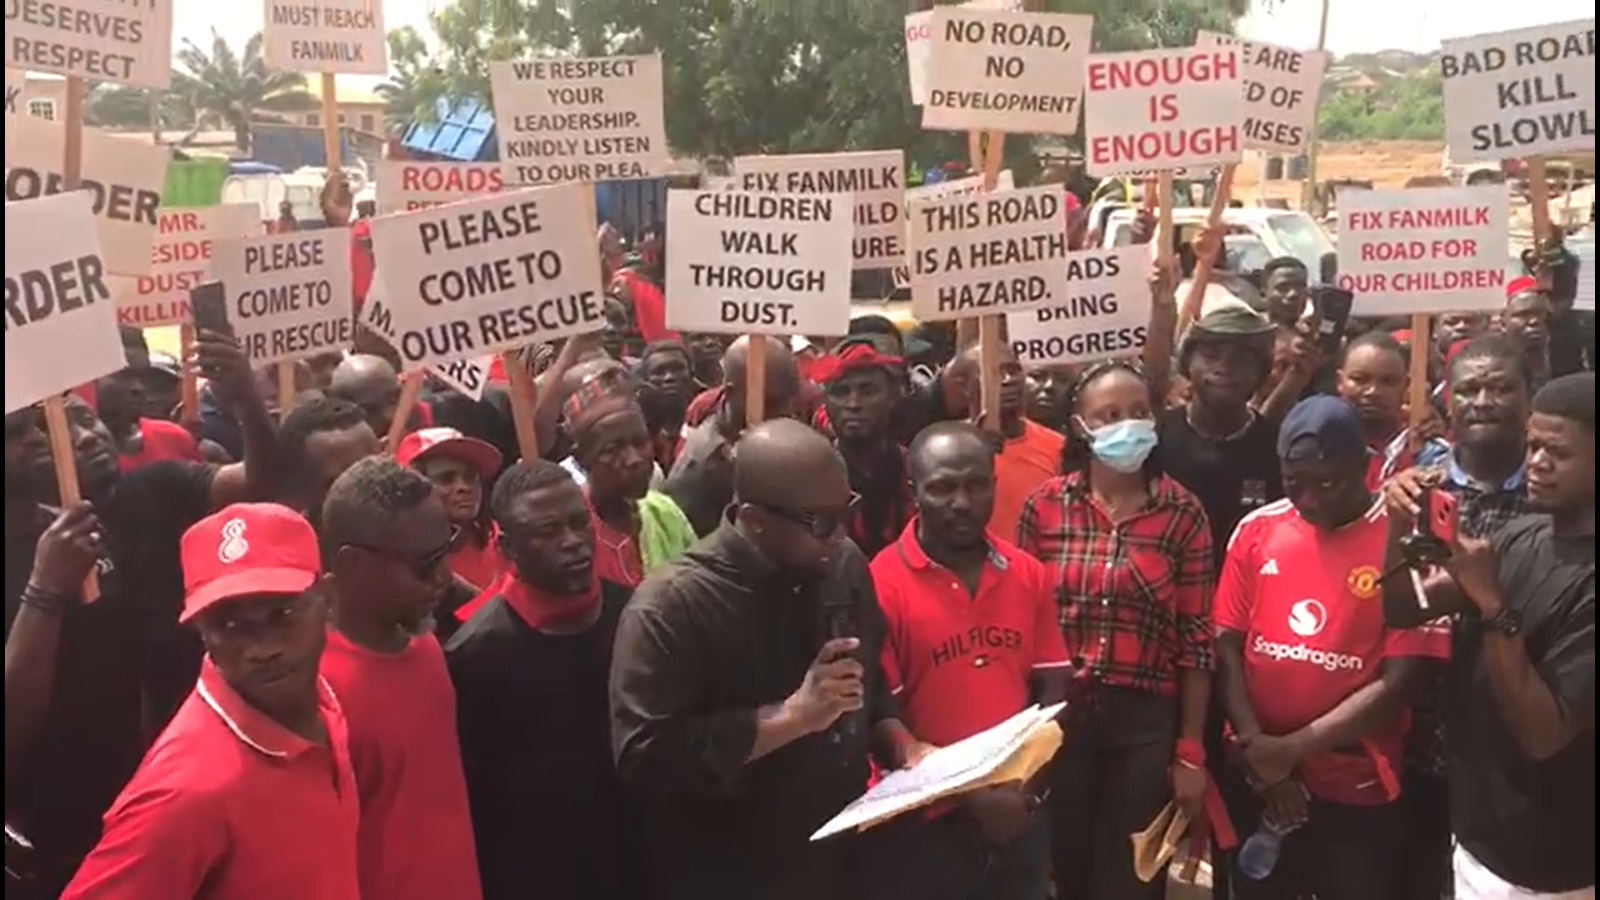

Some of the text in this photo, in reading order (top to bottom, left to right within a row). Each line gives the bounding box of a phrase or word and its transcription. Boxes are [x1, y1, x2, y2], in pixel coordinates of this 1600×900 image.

[273, 5, 376, 29] MUST REACH
[945, 20, 1071, 51] NO ROAD,
[13, 37, 135, 79] RESPECT
[291, 40, 364, 62] FANMILK
[1254, 46, 1303, 73] ARE
[1441, 47, 1506, 78] BAD
[513, 60, 636, 80] WE RESPECT
[986, 56, 1024, 78] NO
[1088, 51, 1237, 91] ENOUGH
[547, 87, 604, 105] YOUR
[930, 89, 1077, 114] DEVELOPMENT
[1270, 86, 1303, 109] OF
[1497, 73, 1577, 109] KILL
[514, 112, 640, 132] LEADERSHIP.
[1149, 95, 1178, 122] IS
[507, 137, 650, 159] KINDLY LISTEN
[1091, 125, 1238, 165] ENOUGH
[402, 165, 503, 193] ROADS
[517, 162, 649, 182] TO OUR PLEA.
[787, 166, 898, 194] FANMILK
[694, 193, 831, 222] CHILDREN
[922, 202, 980, 233] THIS
[987, 194, 1058, 227] ROAD
[1350, 206, 1489, 230] FIX FANMILK
[159, 212, 205, 233] MR.
[419, 201, 542, 255] PLEASE
[245, 239, 324, 274] PLEASE
[721, 231, 797, 256] WALK
[916, 232, 1065, 275] IS A HEALTH
[1362, 239, 1477, 261] ROAD FOR
[419, 250, 561, 306] COME TO
[689, 264, 825, 292] THROUGH
[1339, 270, 1505, 293] OUR CHILDREN
[237, 279, 332, 319] COME TO
[938, 275, 1051, 313] HAZARD.
[402, 291, 605, 361] OUR RESCUE.
[721, 300, 797, 326] DUST.
[1013, 326, 1146, 361] PROGRESS
[931, 625, 1022, 667] HILFIGER
[1253, 636, 1363, 671] Snapdragon
